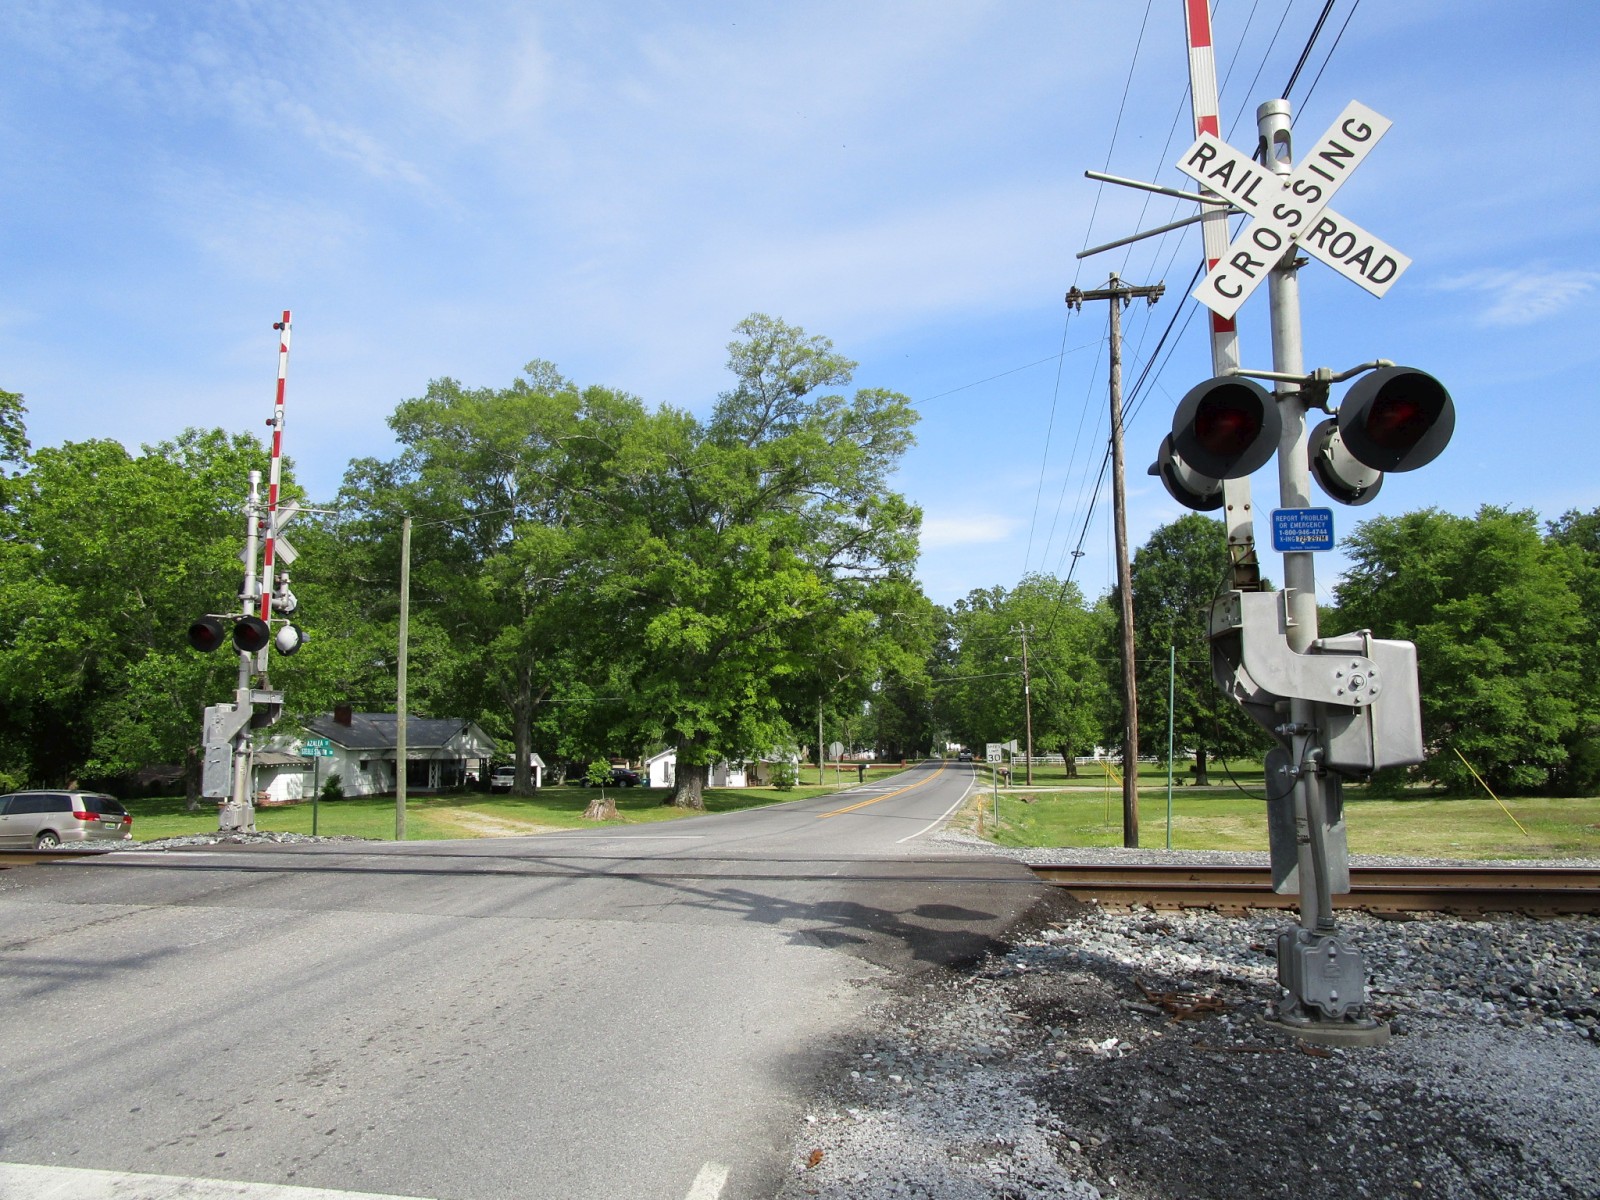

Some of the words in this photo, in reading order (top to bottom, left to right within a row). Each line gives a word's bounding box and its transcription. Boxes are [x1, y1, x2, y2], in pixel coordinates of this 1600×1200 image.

[1187, 142, 1263, 207] RAIL
[1305, 216, 1398, 284] ROAD
[1213, 118, 1372, 299] CROSSING
[988, 753, 1001, 762] 30
